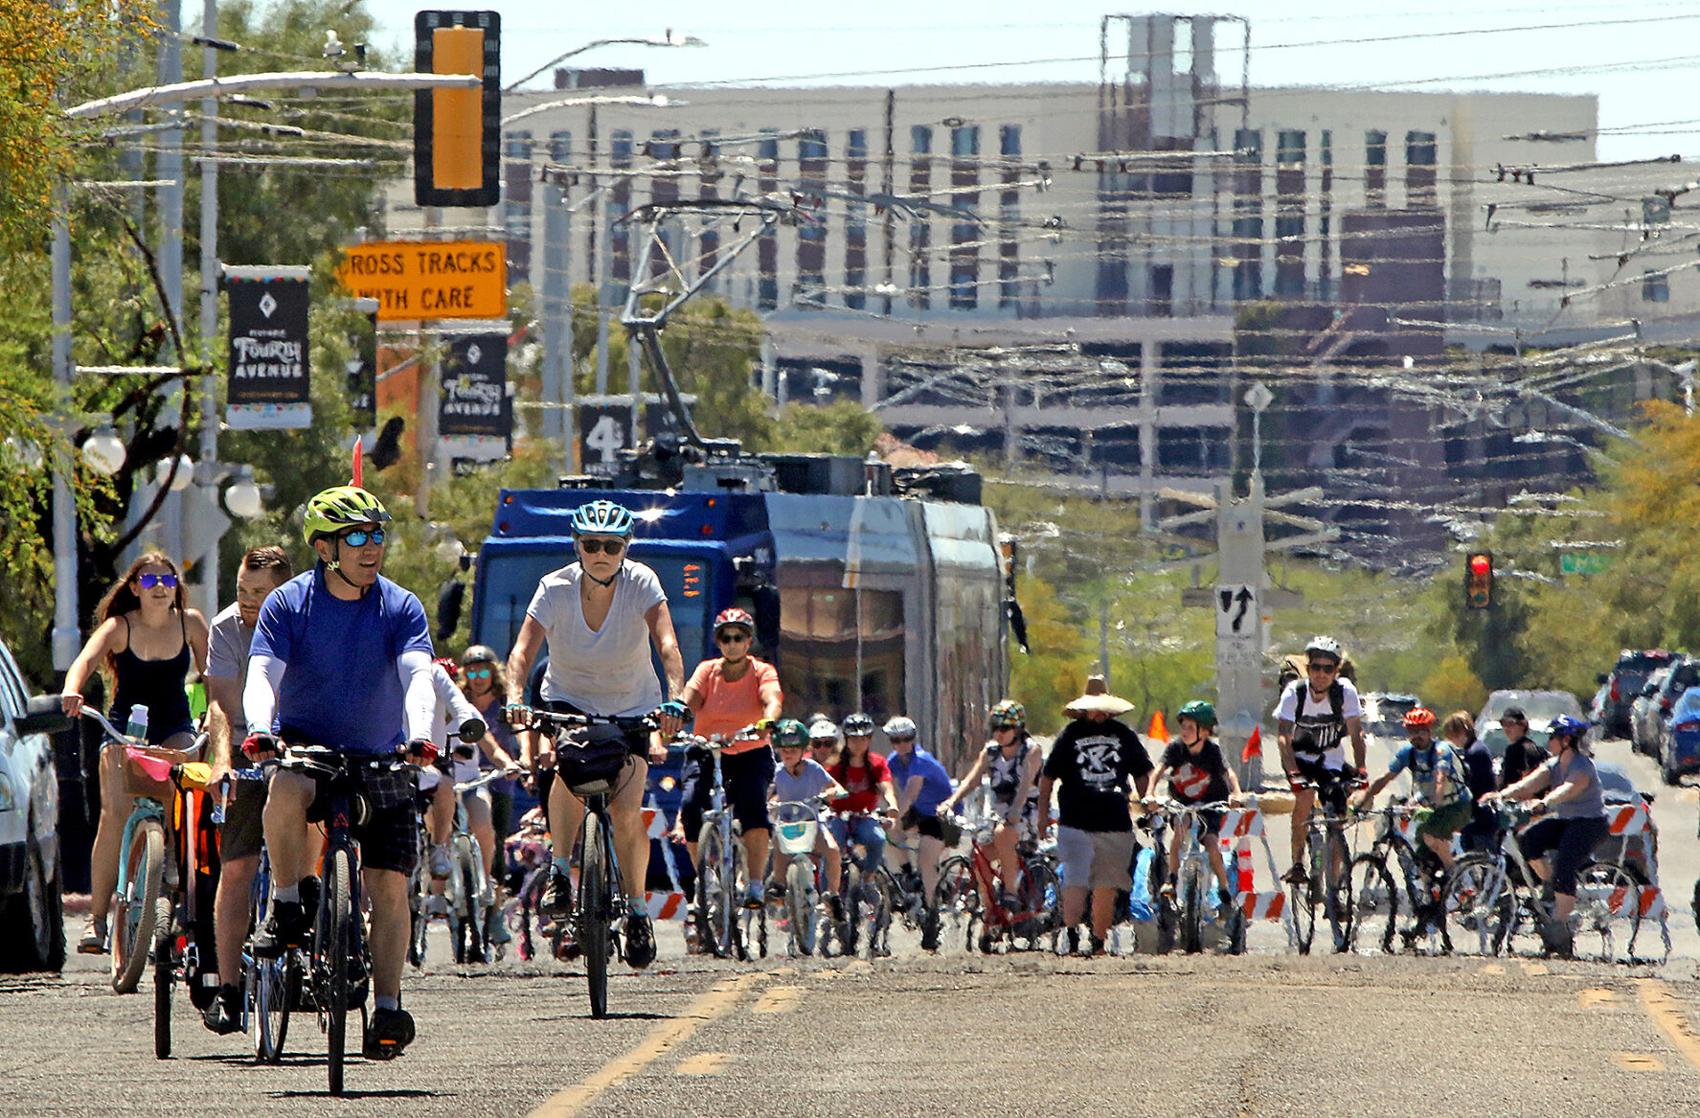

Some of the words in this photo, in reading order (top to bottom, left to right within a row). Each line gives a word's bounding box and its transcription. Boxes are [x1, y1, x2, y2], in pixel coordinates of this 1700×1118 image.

[417, 251, 496, 274] TRACKS
[420, 286, 475, 310] CARE
[235, 363, 303, 378] AVENUE
